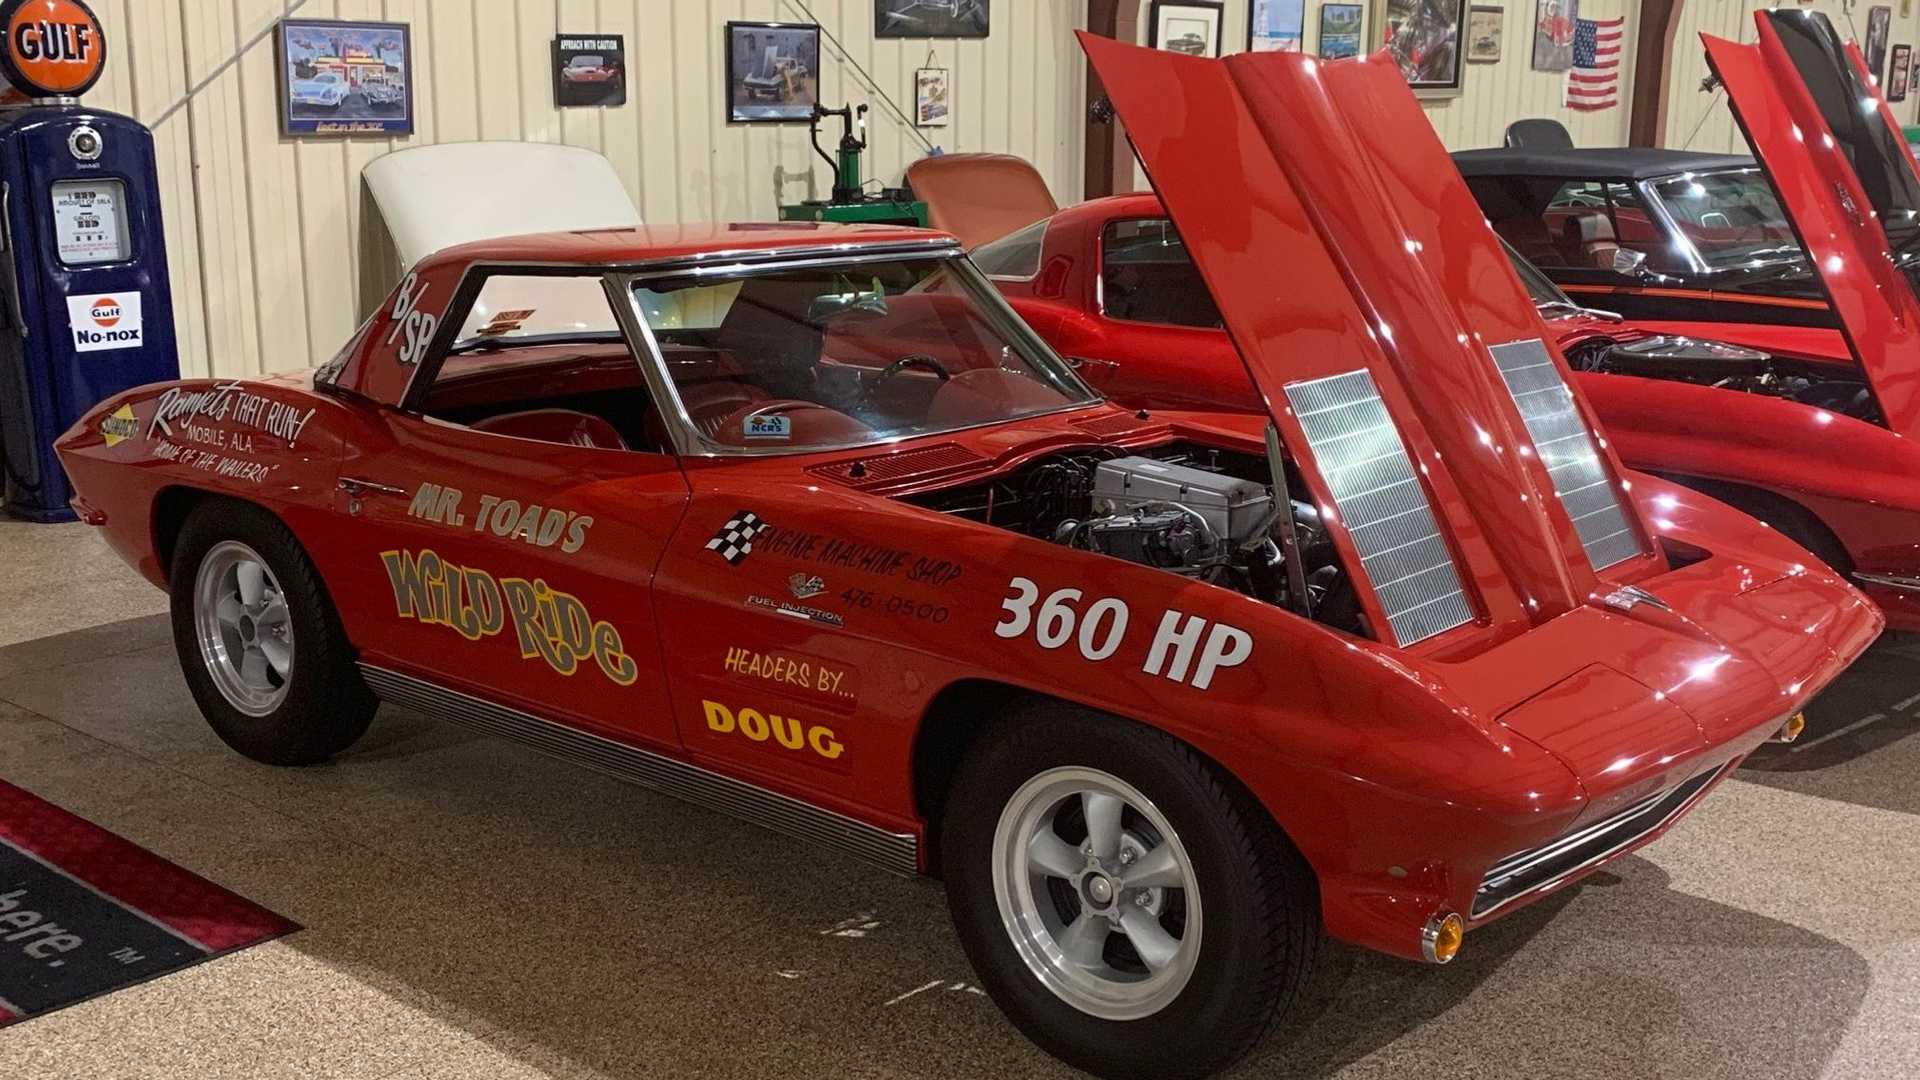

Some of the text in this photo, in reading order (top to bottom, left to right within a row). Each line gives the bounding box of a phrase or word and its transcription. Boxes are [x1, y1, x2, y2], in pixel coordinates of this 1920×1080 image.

[15, 21, 93, 64] GULF
[597, 39, 618, 50] CAUTION
[91, 307, 121, 318] Gulf
[76, 328, 140, 345] No-nox
[231, 391, 271, 429] THAT
[264, 401, 316, 449] RUN!
[751, 424, 783, 434] NCRS
[179, 448, 197, 465] OF
[191, 451, 219, 472] THE
[407, 482, 594, 554] MR. TOAD'S
[815, 536, 912, 577] MACHINE
[906, 554, 964, 587] SHOP
[747, 593, 844, 624] FUEL INJECTION
[993, 576, 1254, 690] 360 HP
[724, 645, 811, 688] HEADERS
[701, 698, 845, 759] DOUG
